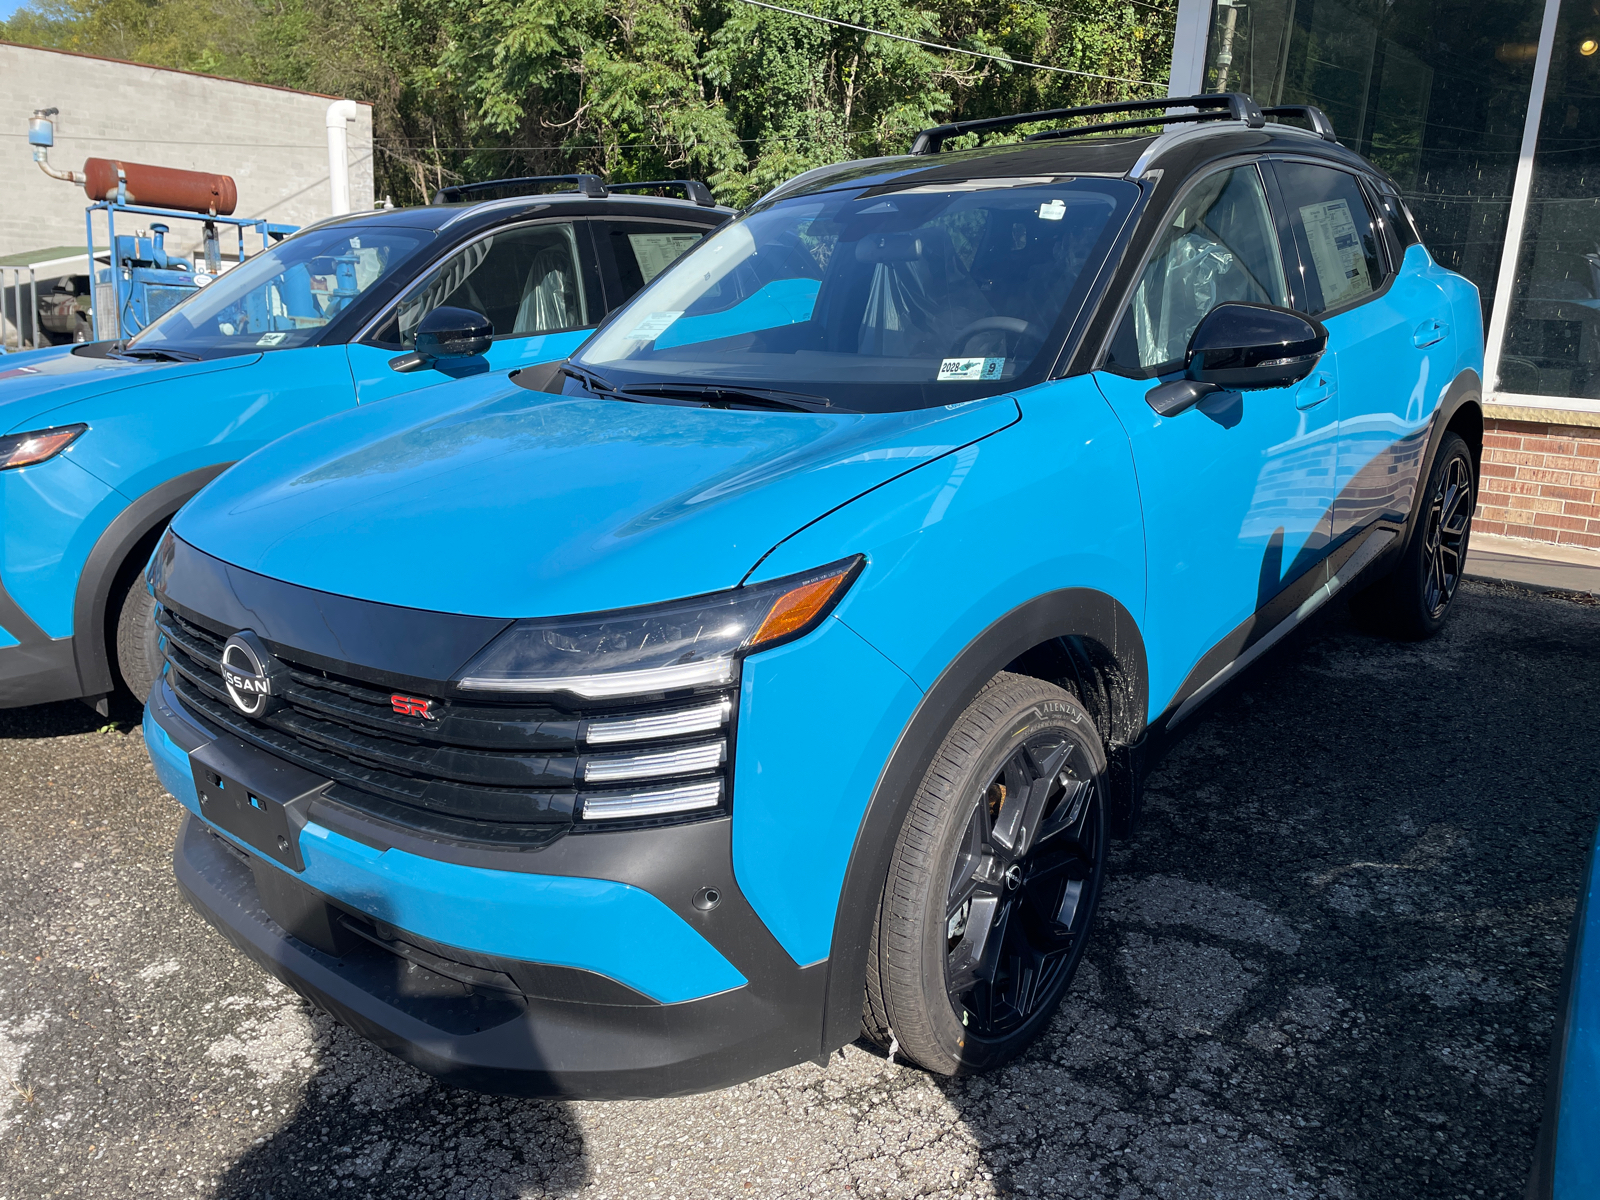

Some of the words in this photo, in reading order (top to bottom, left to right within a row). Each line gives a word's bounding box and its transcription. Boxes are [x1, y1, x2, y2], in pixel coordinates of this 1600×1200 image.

[941, 362, 960, 373] 2028
[988, 362, 997, 373] 9
[391, 695, 431, 720] SR
[1043, 702, 1076, 717] ALENZA
